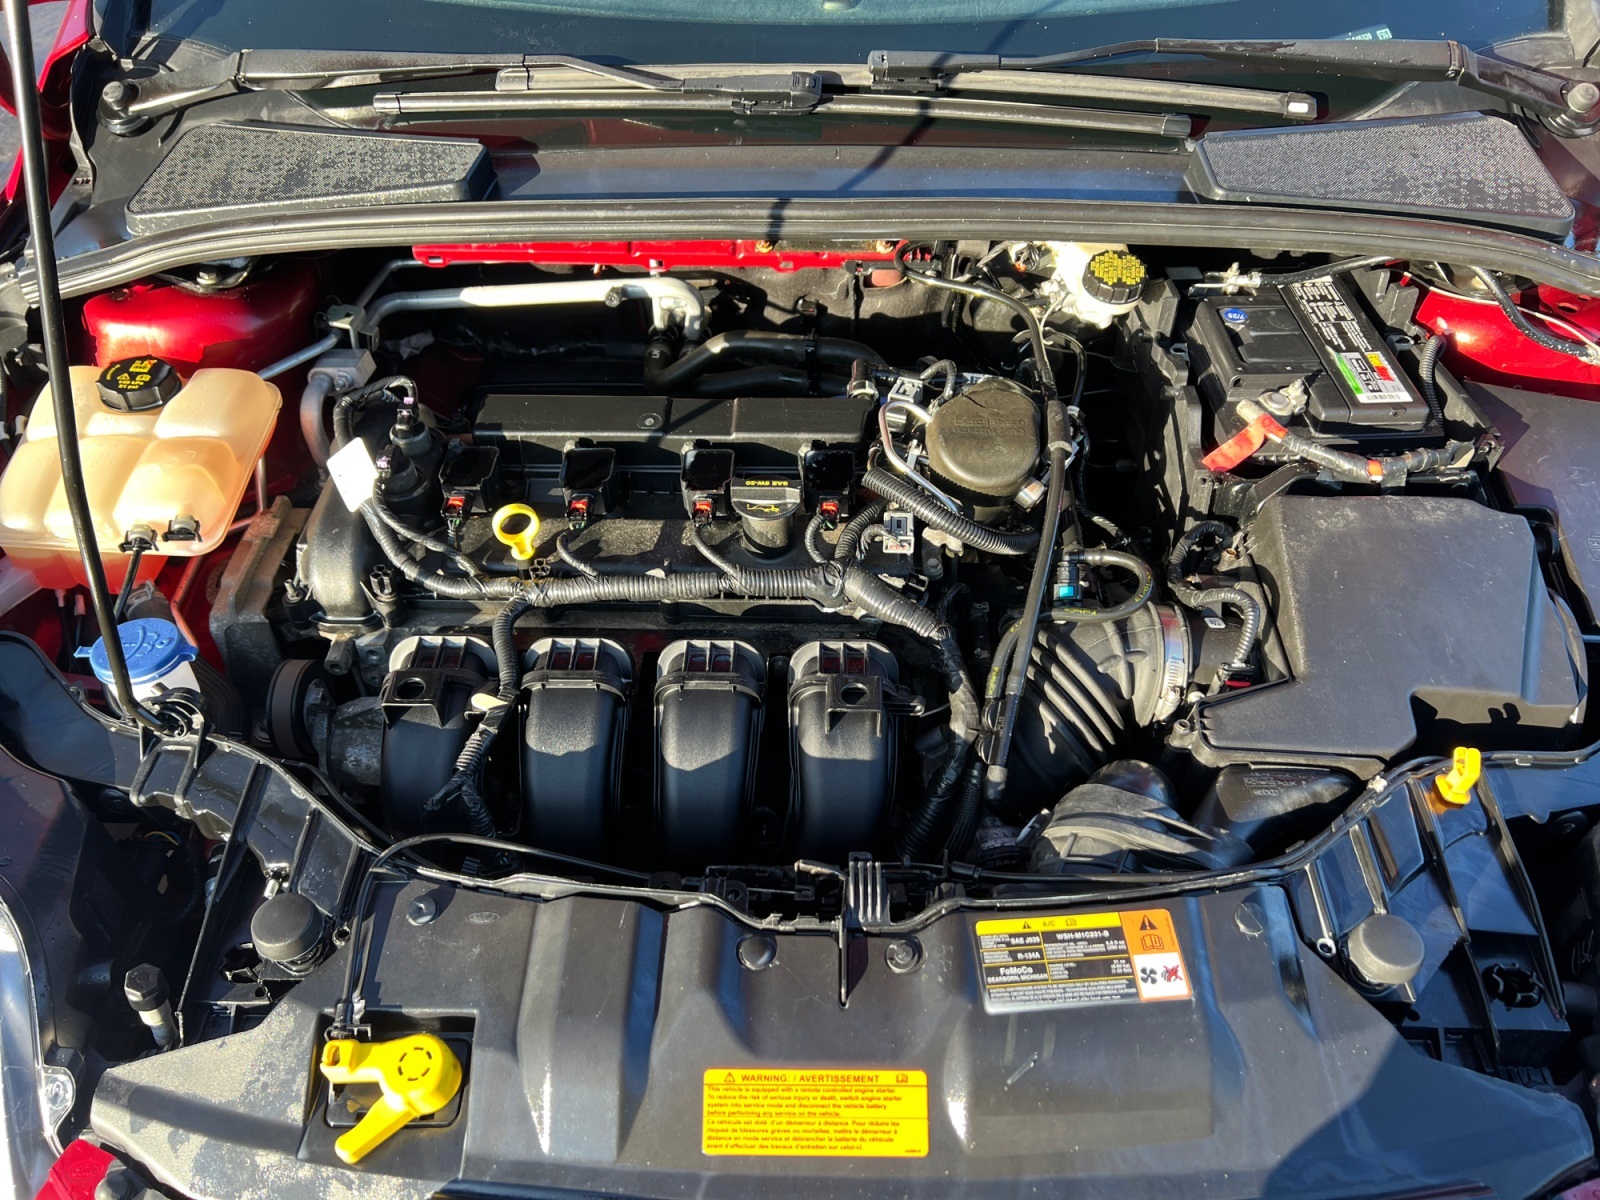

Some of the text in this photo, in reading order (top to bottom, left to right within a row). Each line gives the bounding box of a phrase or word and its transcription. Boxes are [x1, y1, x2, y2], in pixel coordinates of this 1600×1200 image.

[1227, 312, 1245, 320] 7/25
[1063, 607, 1097, 616] FoMoCo
[1010, 937, 1025, 945] SAE
[1017, 951, 1041, 960] R-134A
[999, 965, 1034, 976] FoMoCo
[987, 975, 1020, 984] DEARBORN,
[1020, 973, 1049, 981] MICHIGAN
[741, 1074, 790, 1082] WARNING:
[798, 1074, 880, 1083] AVERTISSEMENT
[751, 1086, 779, 1094] equipped
[793, 1094, 810, 1102] injury
[707, 1101, 729, 1109] system
[866, 1102, 887, 1110] battery
[728, 1109, 760, 1117] performing
